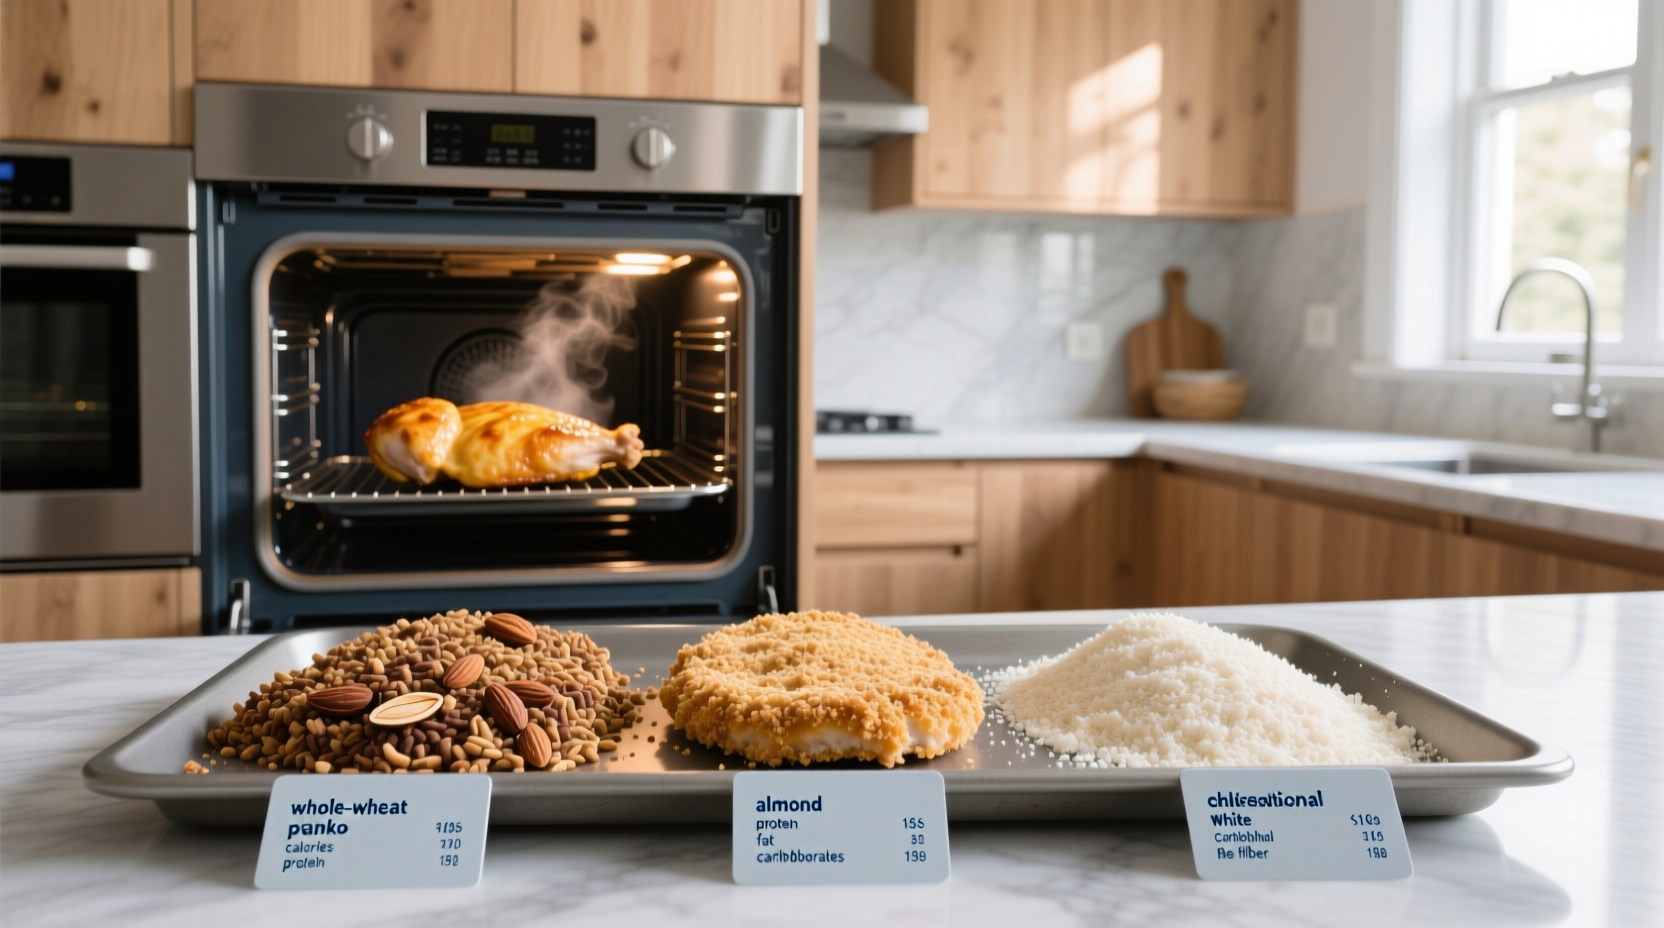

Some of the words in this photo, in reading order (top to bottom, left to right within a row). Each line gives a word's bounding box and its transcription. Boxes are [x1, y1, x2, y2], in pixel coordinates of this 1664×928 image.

[290, 798, 408, 815] whole-wheat
[756, 795, 823, 812] almond
[1210, 811, 1252, 827] White
[287, 819, 349, 840] panko
[756, 833, 775, 847] fat
